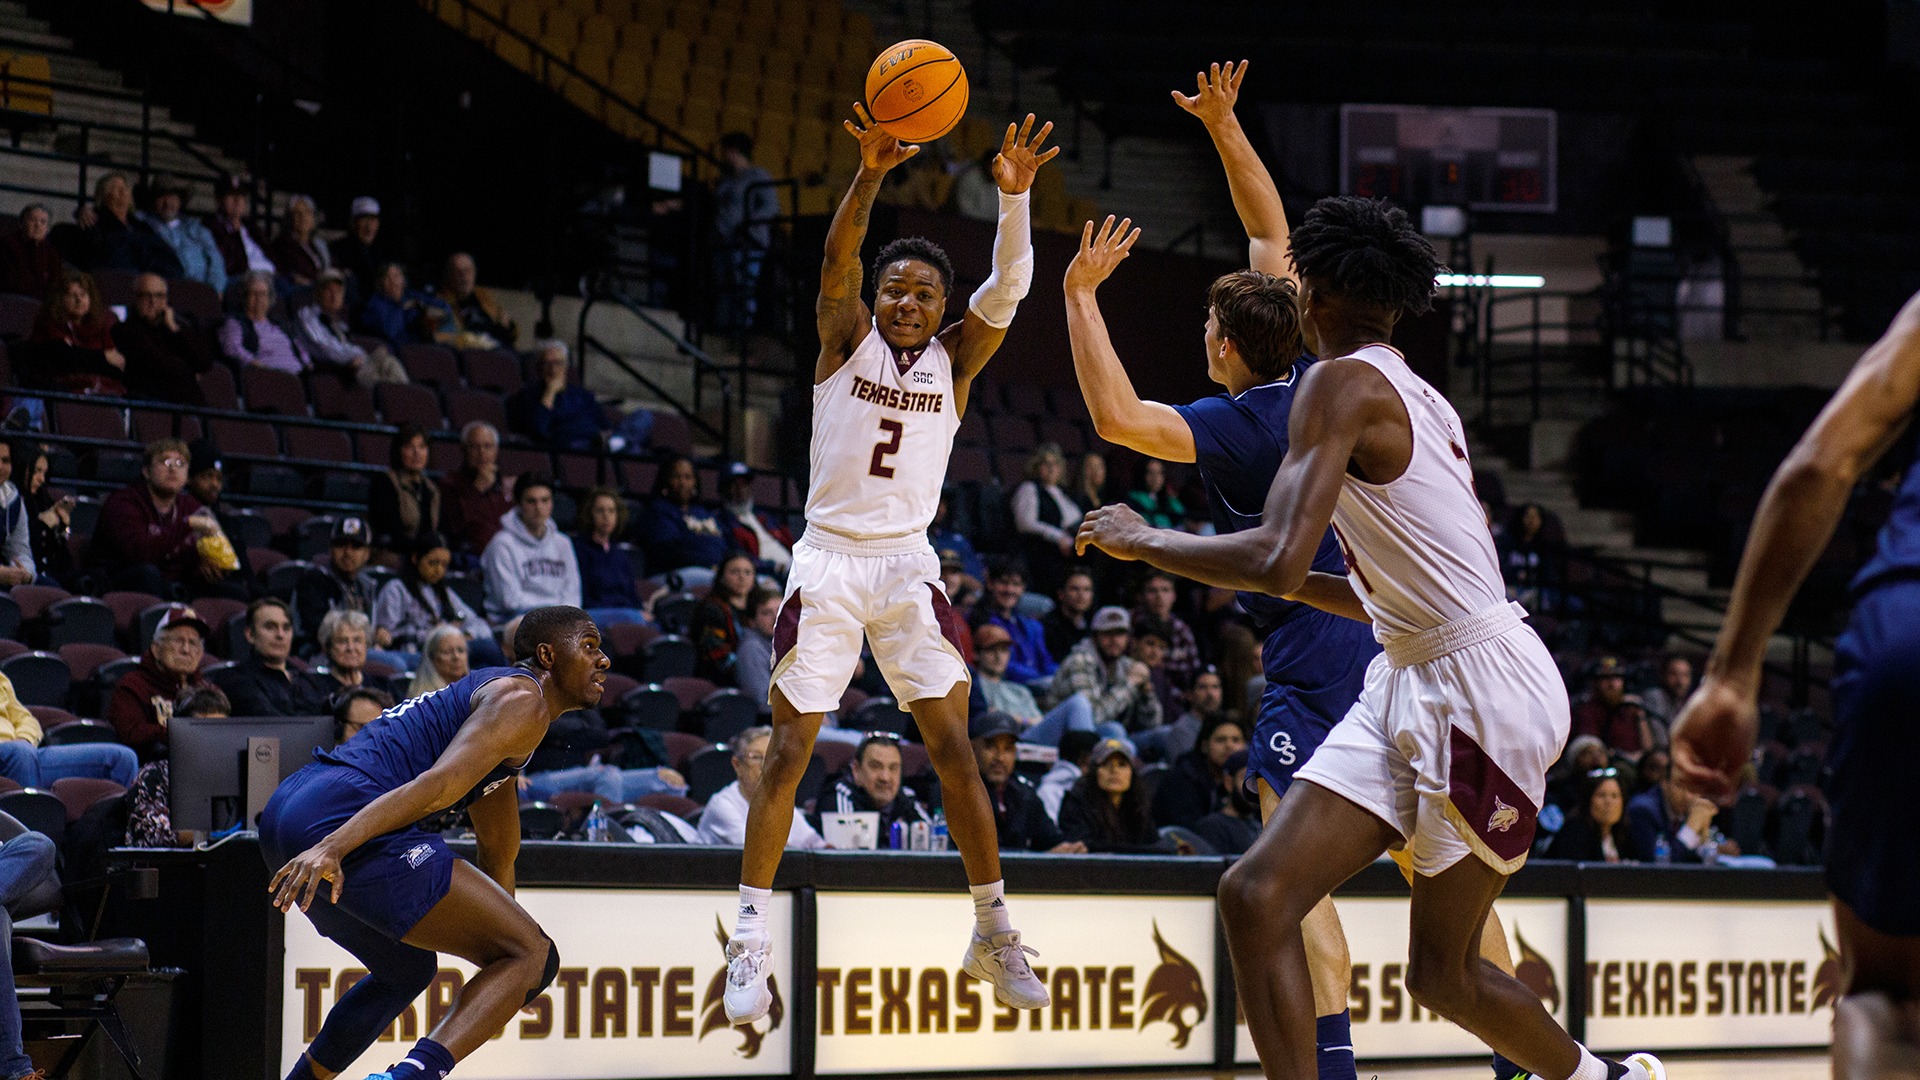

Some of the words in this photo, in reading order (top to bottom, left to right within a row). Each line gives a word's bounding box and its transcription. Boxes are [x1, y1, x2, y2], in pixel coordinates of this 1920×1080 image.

[850, 375, 900, 410] TEXAS
[899, 391, 944, 413] STATE
[913, 371, 933, 384] SBC
[868, 415, 904, 480] 2
[1270, 731, 1297, 766] GS
[816, 967, 982, 1036] TEXAS
[1585, 961, 1697, 1018] TEXAS
[1706, 961, 1806, 1016] STATE
